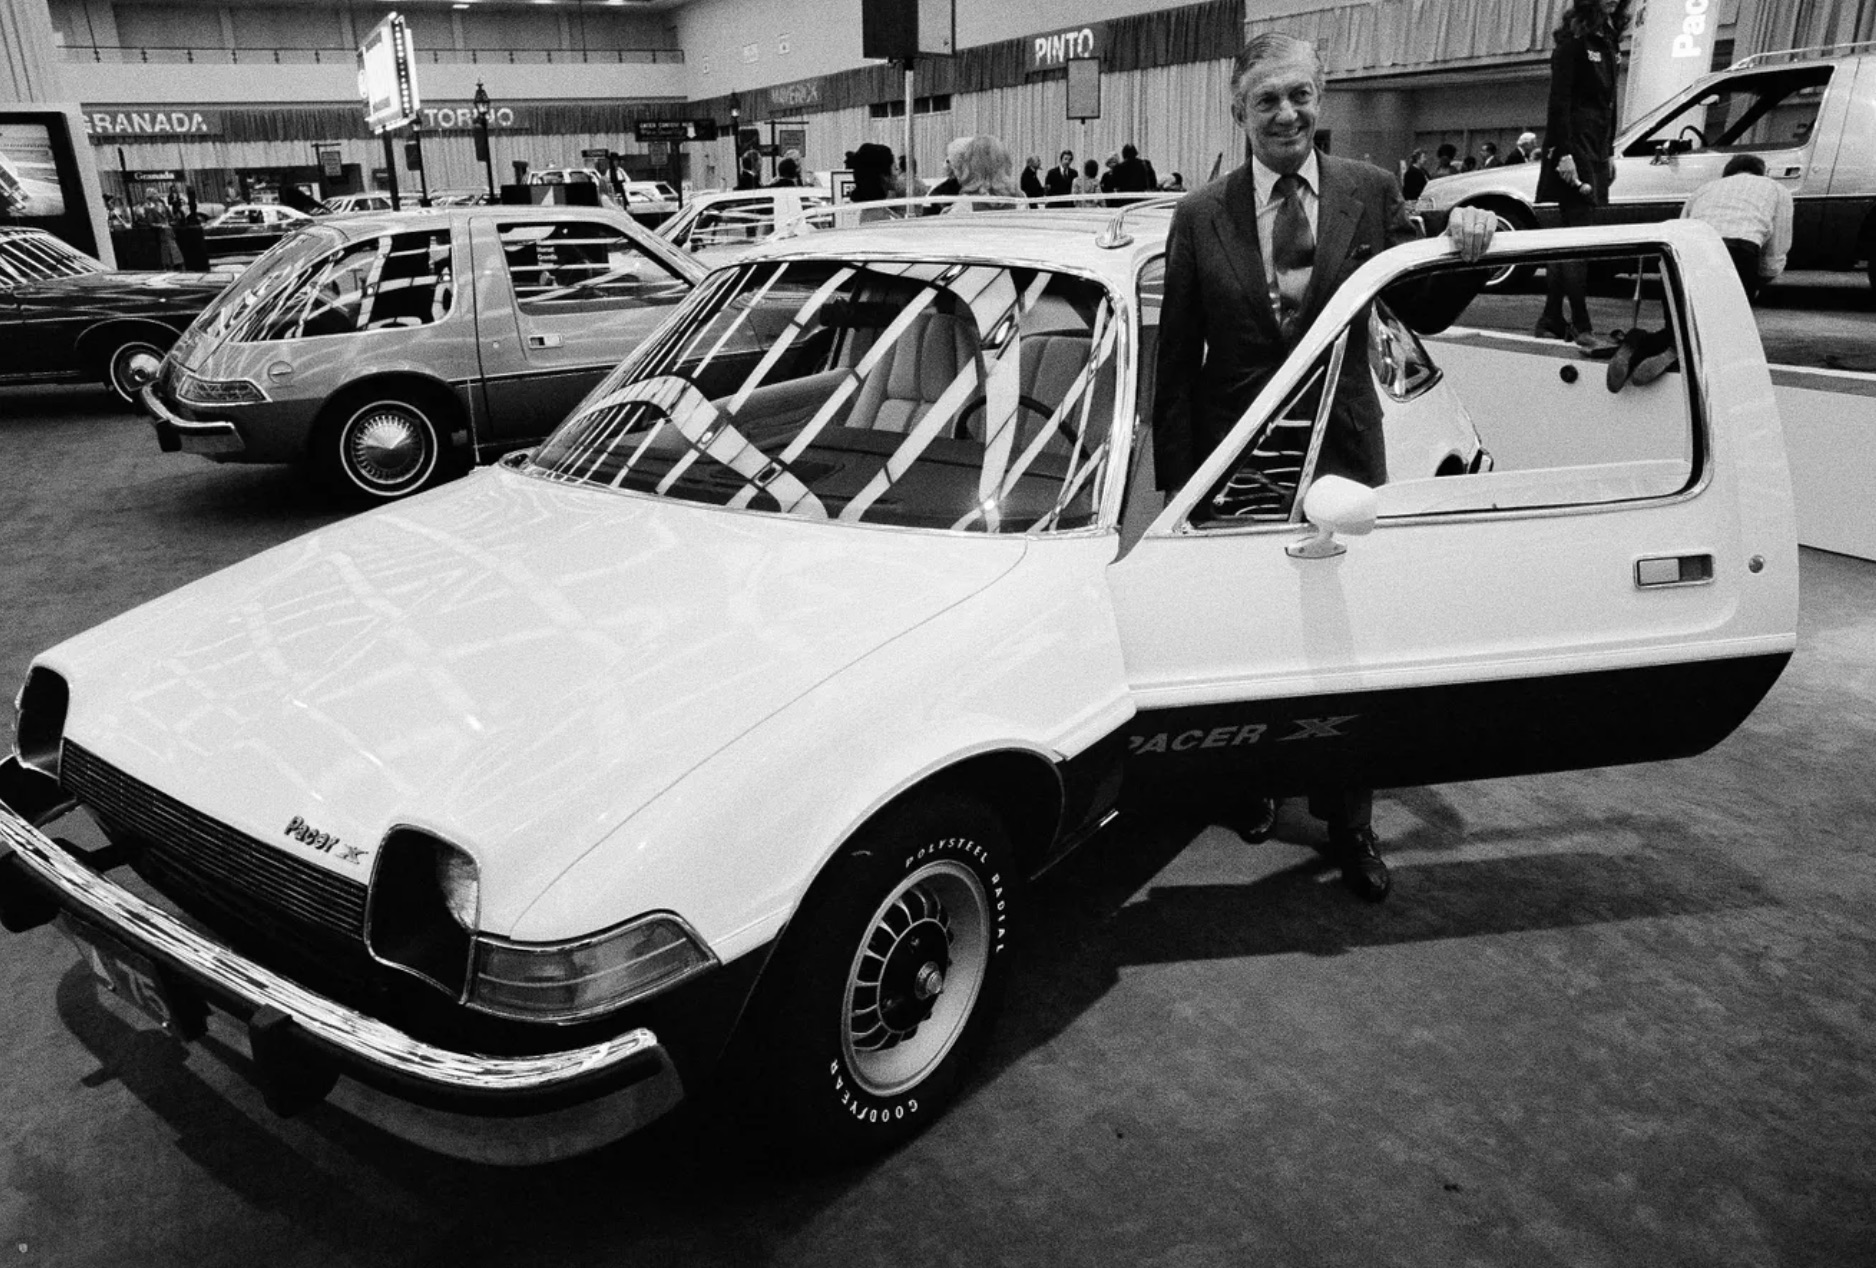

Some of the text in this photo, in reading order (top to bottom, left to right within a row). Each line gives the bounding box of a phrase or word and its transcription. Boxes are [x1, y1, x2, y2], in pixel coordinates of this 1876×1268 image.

[1034, 28, 1094, 66] PINTO
[134, 171, 175, 180] Granada
[1276, 714, 1362, 742] X
[283, 815, 370, 866] Pacer X
[905, 837, 1006, 953] POLYSTEEL RADIAL
[830, 1058, 918, 1123] GOODYEAR
